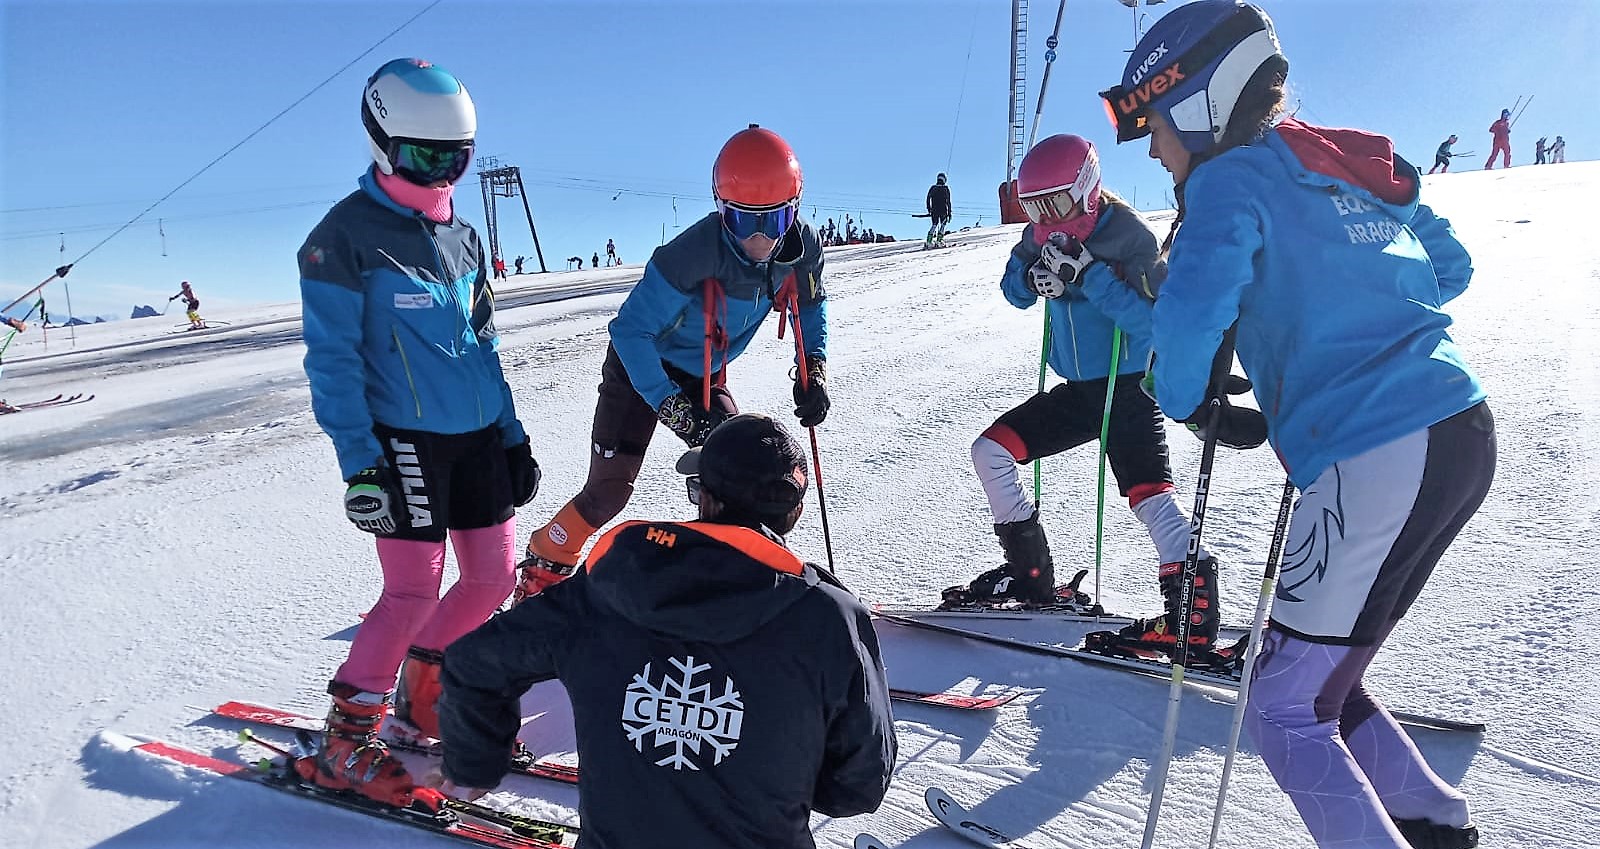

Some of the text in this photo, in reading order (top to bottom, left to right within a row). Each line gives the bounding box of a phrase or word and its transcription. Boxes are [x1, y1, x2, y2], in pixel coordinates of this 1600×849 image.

[1130, 41, 1169, 86] uvex
[371, 89, 388, 119] POC
[1117, 62, 1185, 115] uvex
[390, 437, 433, 528] JULIA
[1188, 473, 1209, 555] HEAD
[645, 526, 677, 548] HH
[633, 696, 731, 735] CETDI
[657, 726, 701, 741] ARAGÓN
